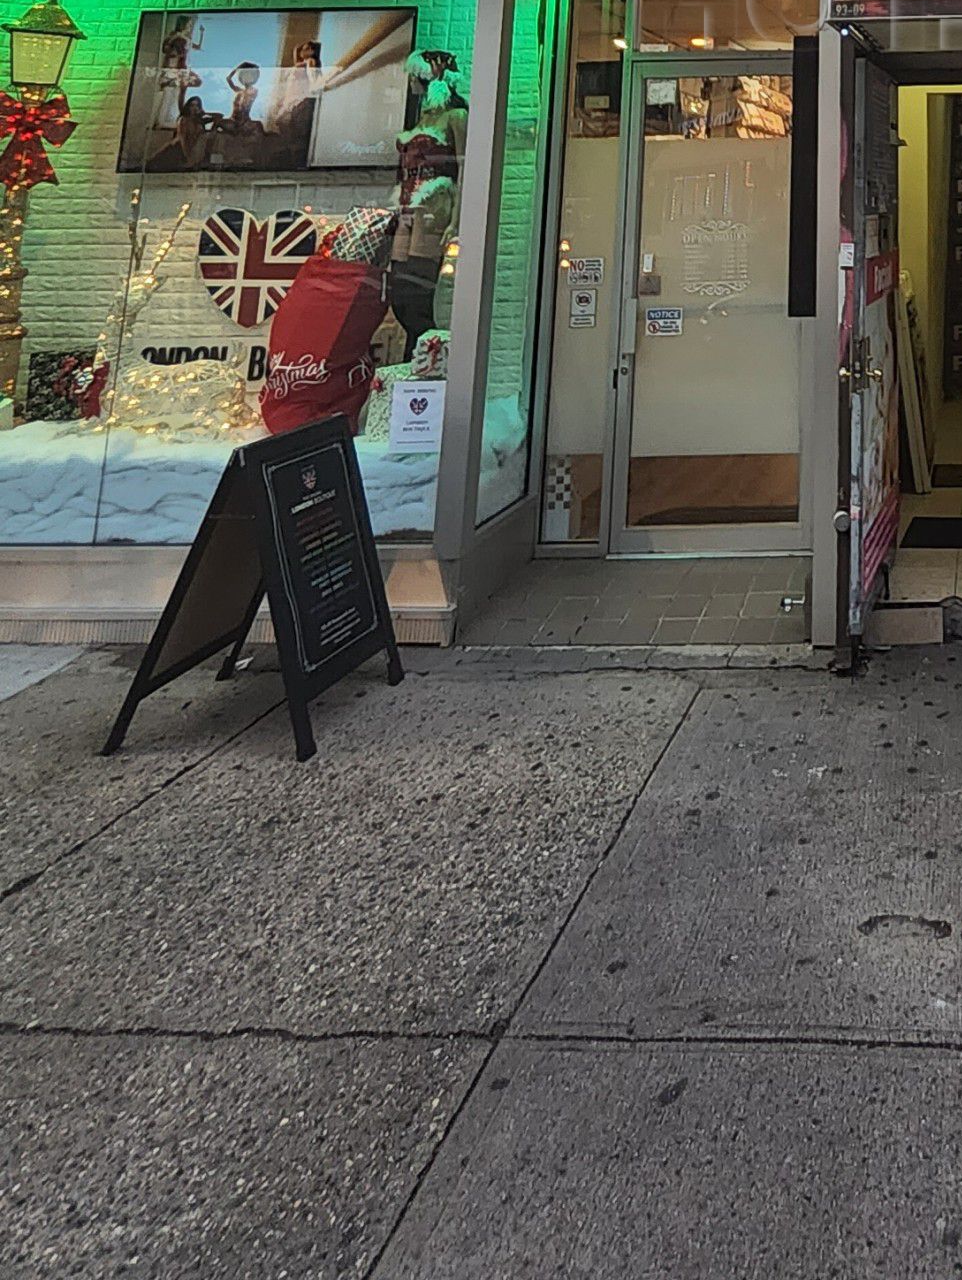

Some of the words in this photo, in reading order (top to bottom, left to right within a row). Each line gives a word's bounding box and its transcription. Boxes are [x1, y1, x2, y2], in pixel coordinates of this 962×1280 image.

[836, 3, 866, 16] 93-09
[570, 260, 585, 272] NO
[649, 310, 680, 319] NOTICE
